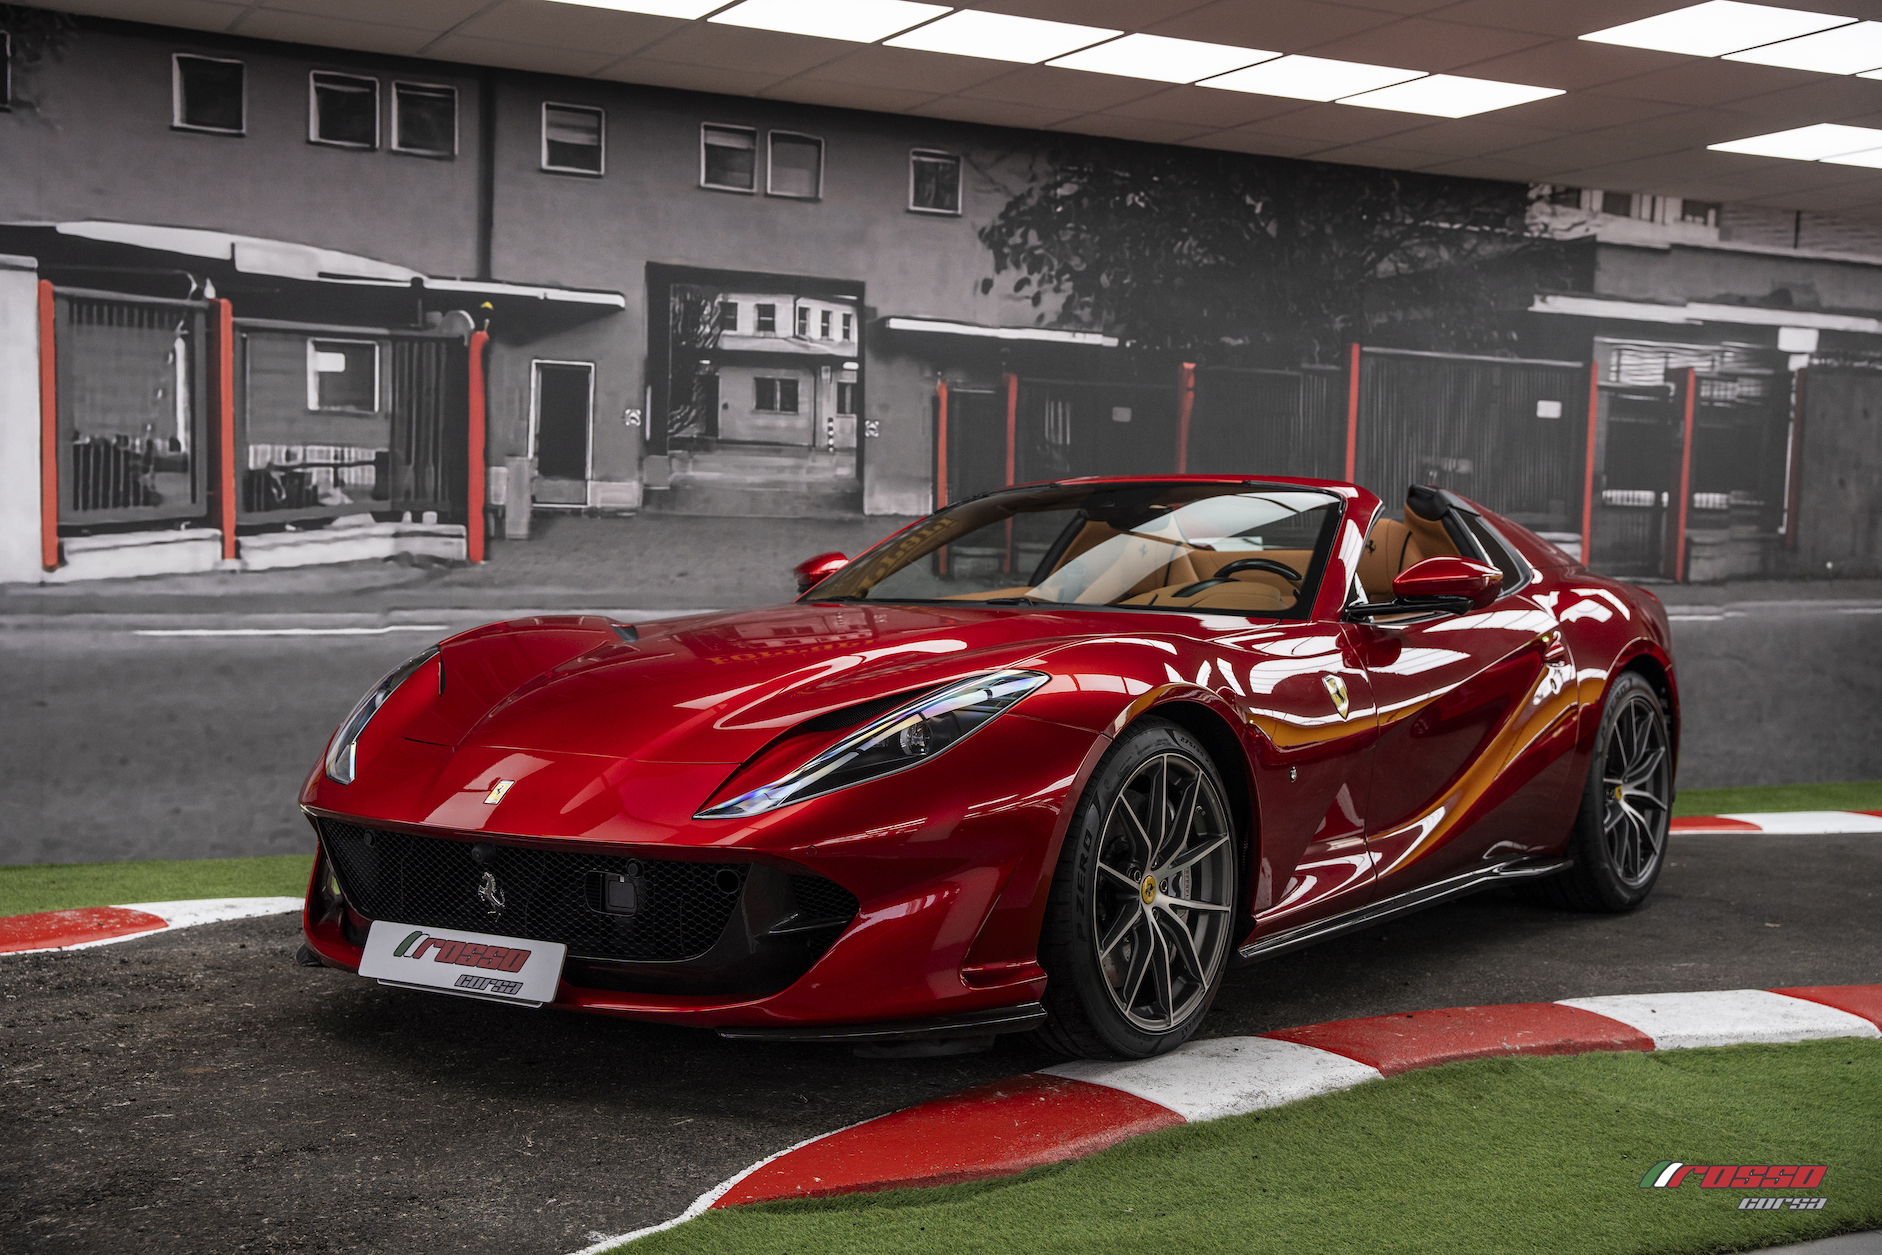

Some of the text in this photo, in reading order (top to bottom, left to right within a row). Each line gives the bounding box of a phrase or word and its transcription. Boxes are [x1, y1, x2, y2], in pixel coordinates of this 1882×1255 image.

[1076, 828, 1093, 942] P ZERO
[412, 937, 532, 973] rosso
[454, 974, 524, 995] corsa
